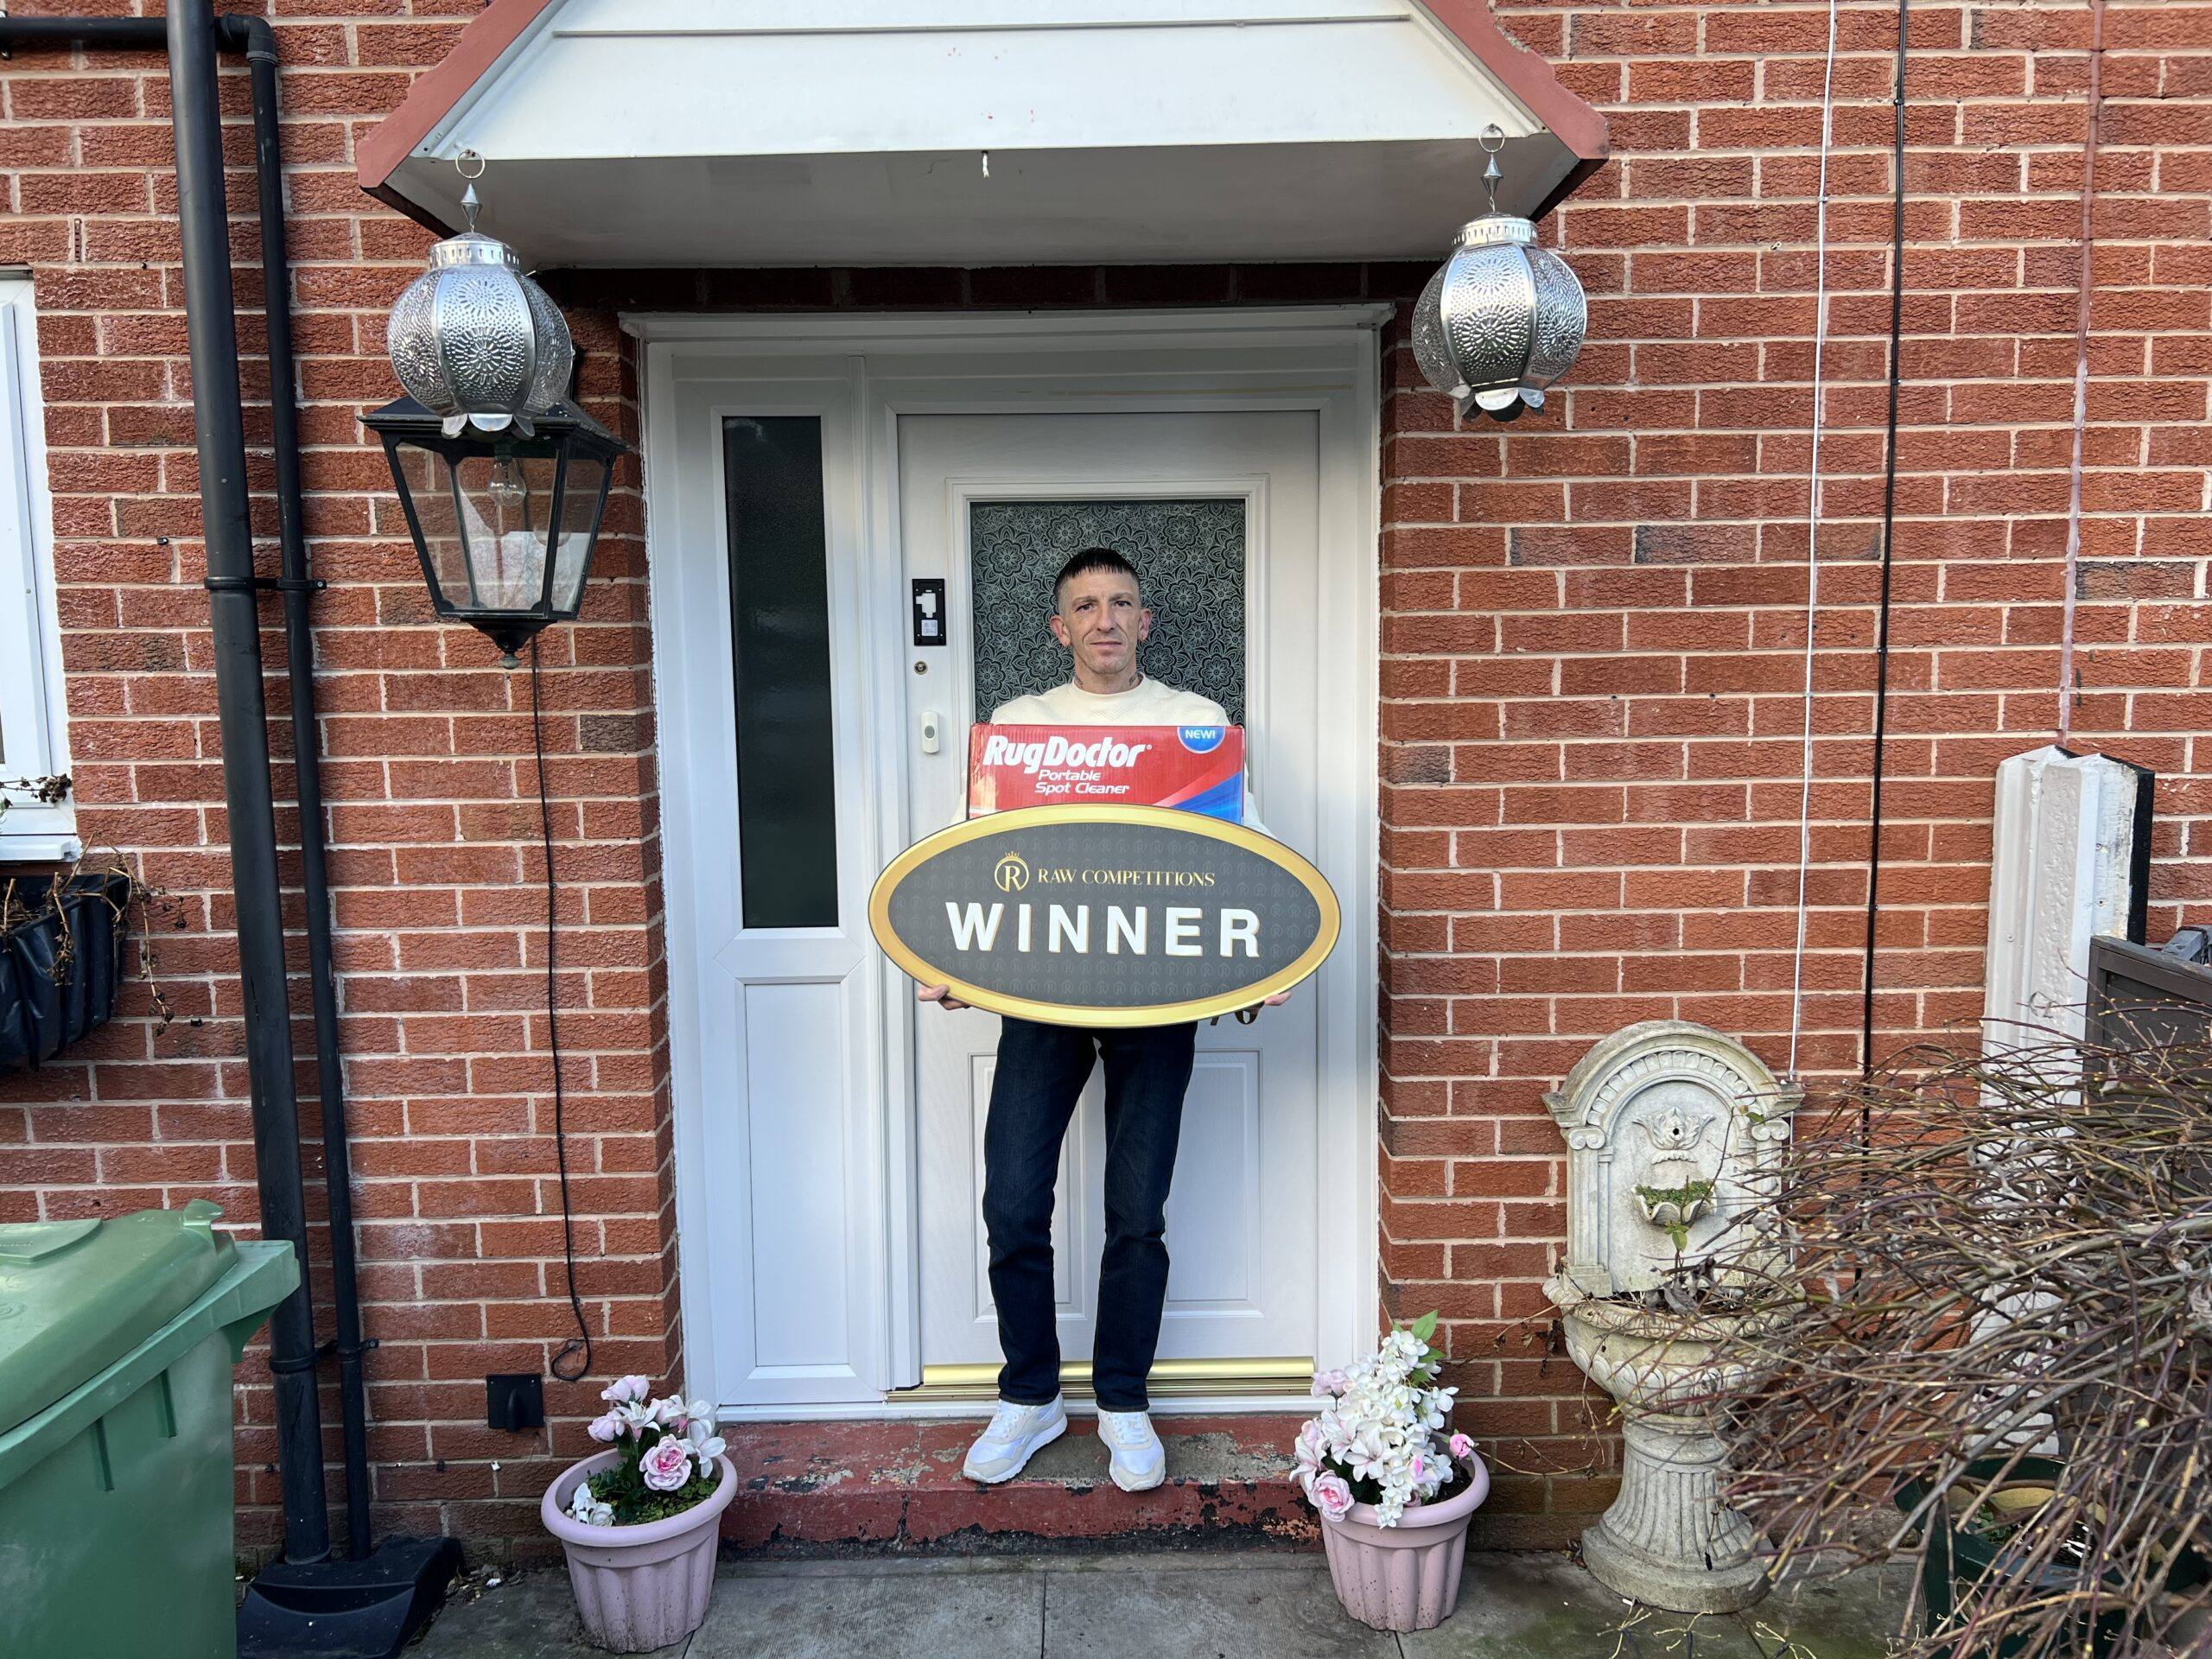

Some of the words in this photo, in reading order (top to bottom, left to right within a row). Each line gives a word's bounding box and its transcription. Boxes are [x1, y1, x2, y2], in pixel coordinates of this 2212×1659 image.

[1185, 729, 1216, 740] NEW!
[1038, 769, 1102, 781] Portable
[1034, 782, 1071, 796] Spot
[1075, 782, 1130, 794] Cleaner
[1038, 868, 1077, 883] RAW
[1082, 869, 1216, 887] COMPETITIONS
[945, 901, 1262, 958] WINNER
